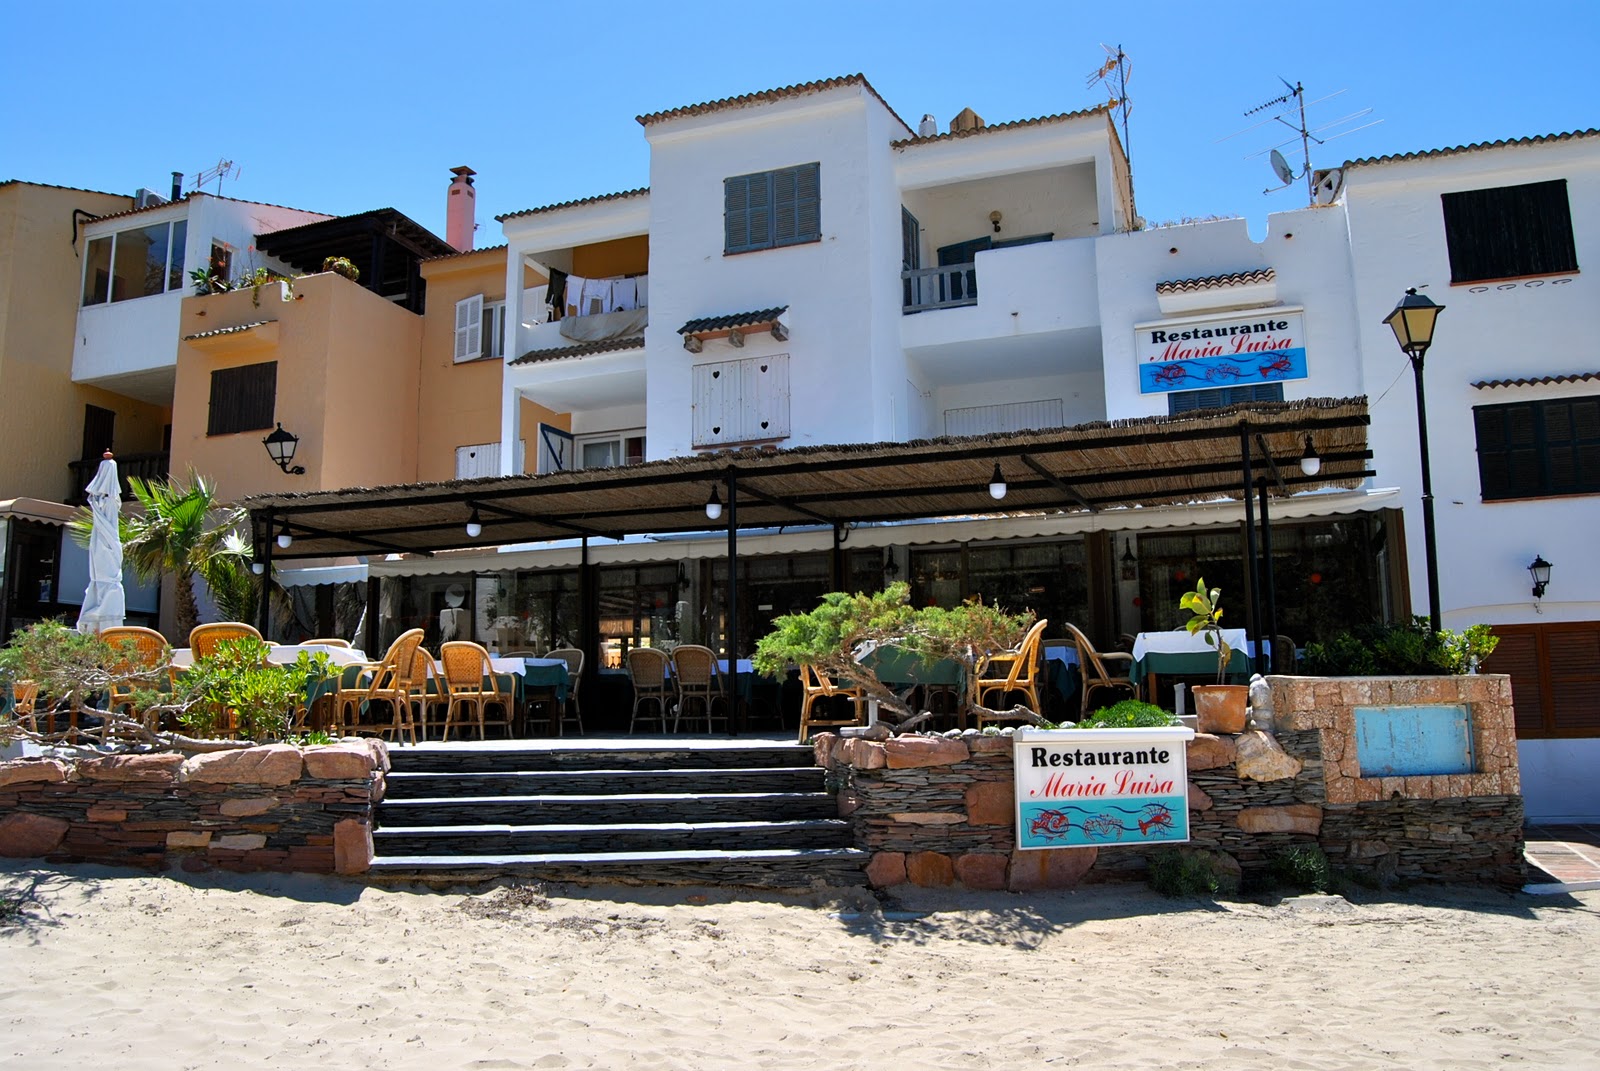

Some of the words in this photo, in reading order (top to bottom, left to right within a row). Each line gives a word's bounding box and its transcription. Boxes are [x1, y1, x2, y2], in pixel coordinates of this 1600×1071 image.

[1151, 320, 1288, 344] Restaurante
[1149, 341, 1224, 362] Maria
[1228, 334, 1293, 355] Luisa
[1031, 747, 1170, 767] Restaurante
[1030, 772, 1107, 798] Maria
[1111, 769, 1174, 795] Luisa
